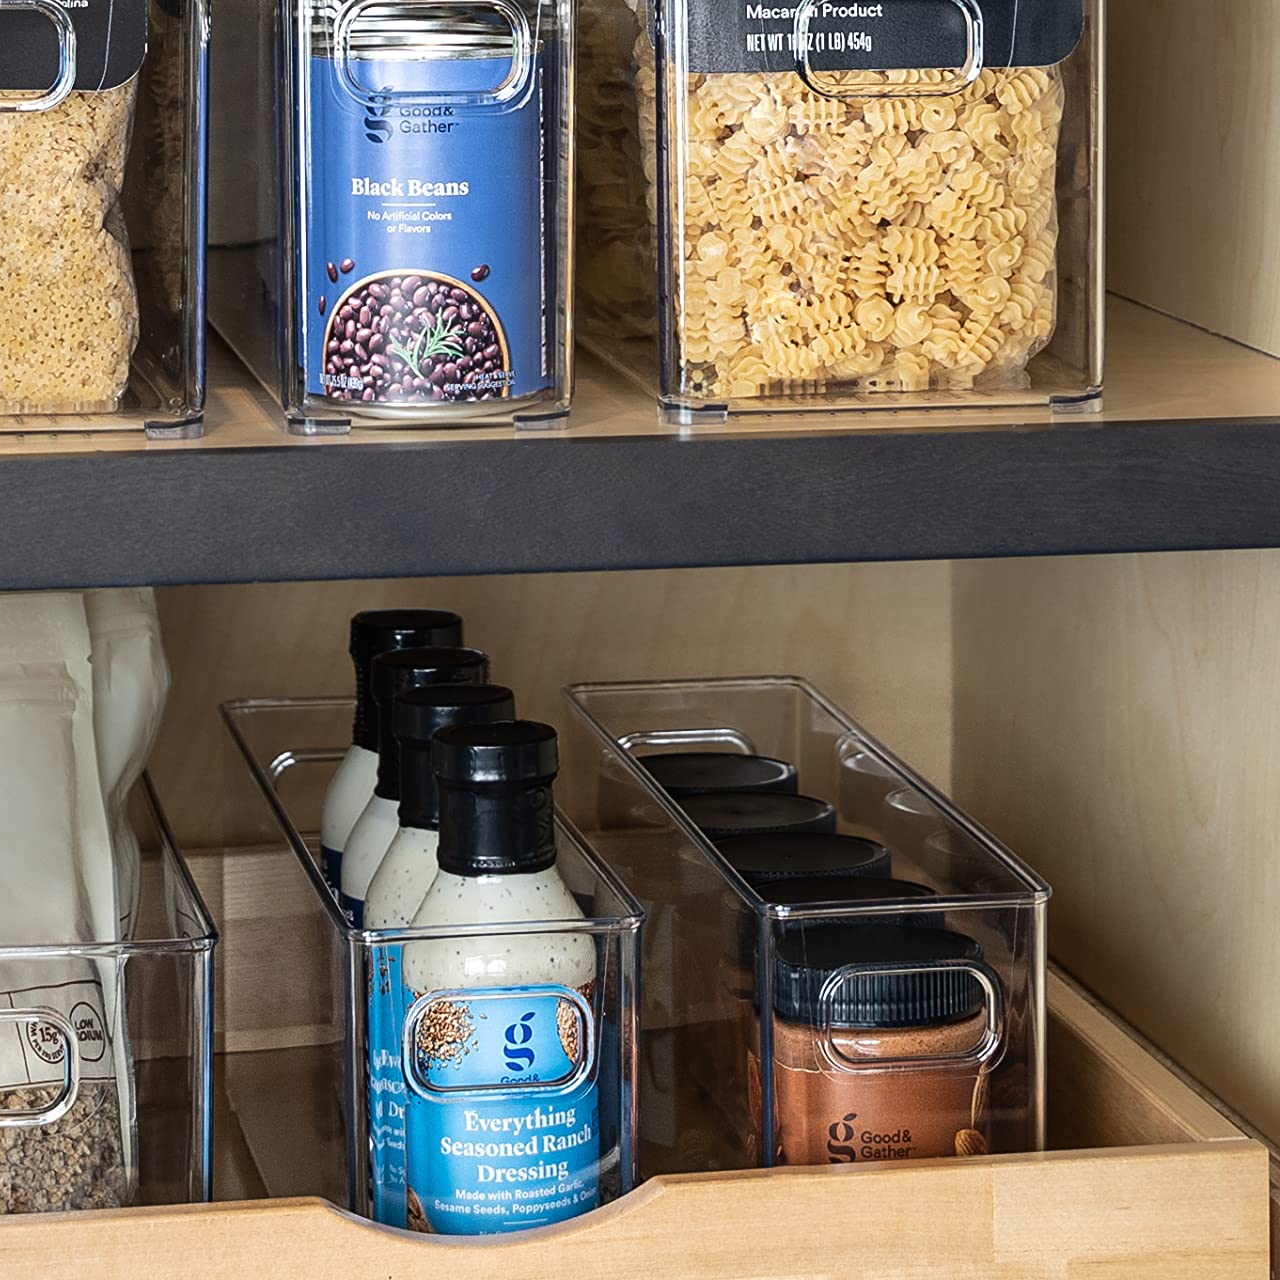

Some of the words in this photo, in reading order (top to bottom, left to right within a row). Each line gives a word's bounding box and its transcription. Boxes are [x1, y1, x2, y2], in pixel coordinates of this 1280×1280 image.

[822, 3, 883, 18] Product
[746, 33, 766, 52] NET
[767, 33, 784, 52] WT
[815, 32, 825, 52] (1
[828, 32, 845, 52] LB)
[847, 32, 872, 52] 454g
[399, 120, 454, 134] Gather
[351, 177, 405, 197] Black
[408, 179, 470, 197] Beans
[367, 210, 380, 221] No
[382, 210, 420, 222] Artificial
[422, 210, 452, 221] Colors
[387, 225, 397, 233] or
[398, 223, 432, 234] Flavors
[74, 1018, 94, 1031] LOW
[39, 1026, 59, 1045] 15g
[463, 1106, 576, 1136] Everything
[440, 1134, 539, 1158] Seasoned
[541, 1123, 592, 1153] Ranch
[860, 1129, 912, 1143] Good&
[860, 1145, 913, 1159] Gather
[477, 1160, 569, 1184] Dressing
[455, 1188, 486, 1201] Made
[487, 1188, 512, 1201] with
[514, 1185, 556, 1200] Roasted
[434, 1199, 471, 1215] Sesame
[472, 1202, 510, 1216] Seeds,
[512, 1197, 571, 1215] Poppyseeds
[572, 1193, 579, 1204] &
